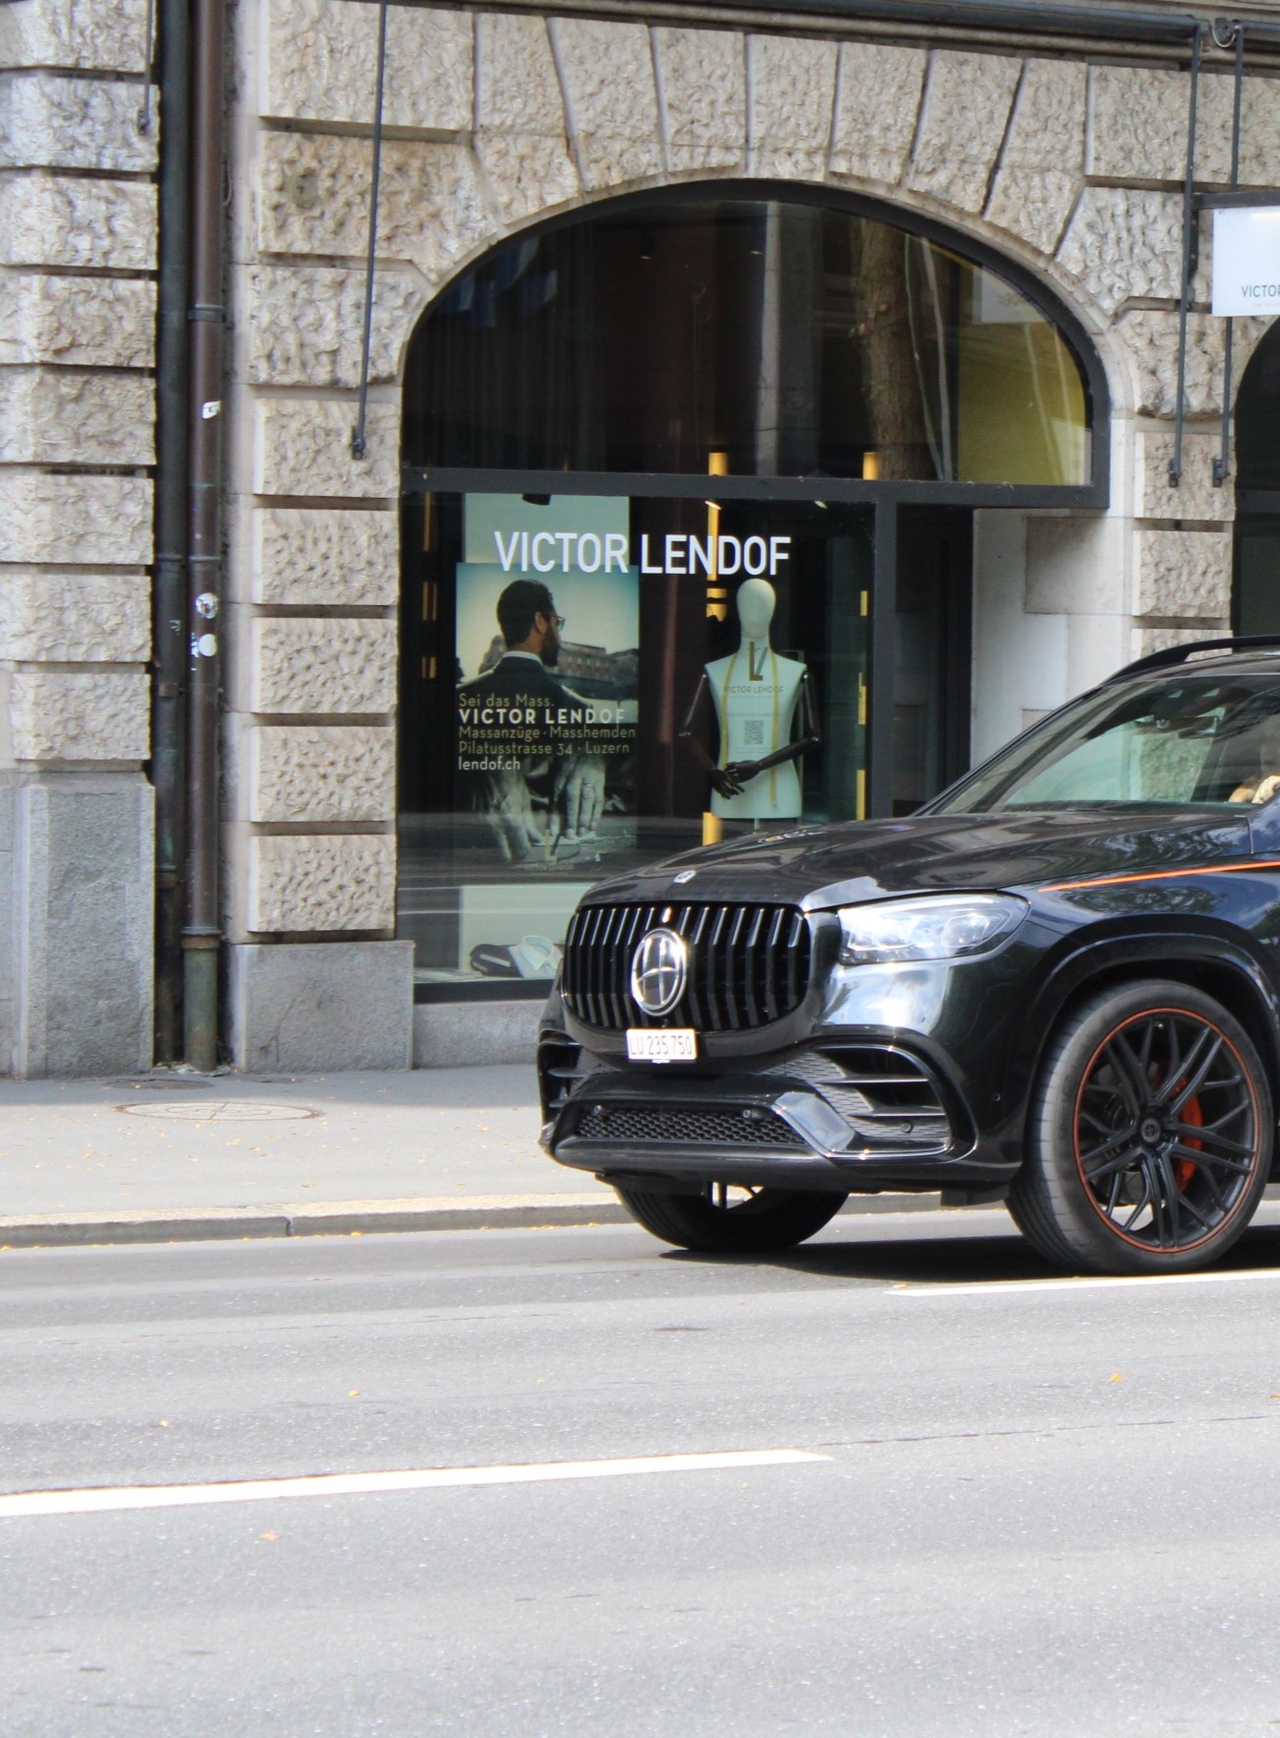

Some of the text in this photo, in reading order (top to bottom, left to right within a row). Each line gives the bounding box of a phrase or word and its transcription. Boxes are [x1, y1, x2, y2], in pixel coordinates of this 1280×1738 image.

[494, 531, 791, 576] VICTOR LENDOF
[459, 693, 554, 707] Sei das Mass.
[459, 708, 625, 724] VICTOR LENDOF
[459, 726, 540, 742] Massanzüge
[550, 725, 636, 739] Masshemden
[459, 741, 552, 755] Pilatusstrasse
[557, 744, 573, 756] 34
[586, 742, 630, 754] Luzern
[458, 757, 521, 771] lendof.ch
[629, 1035, 692, 1055] LU 235 750
